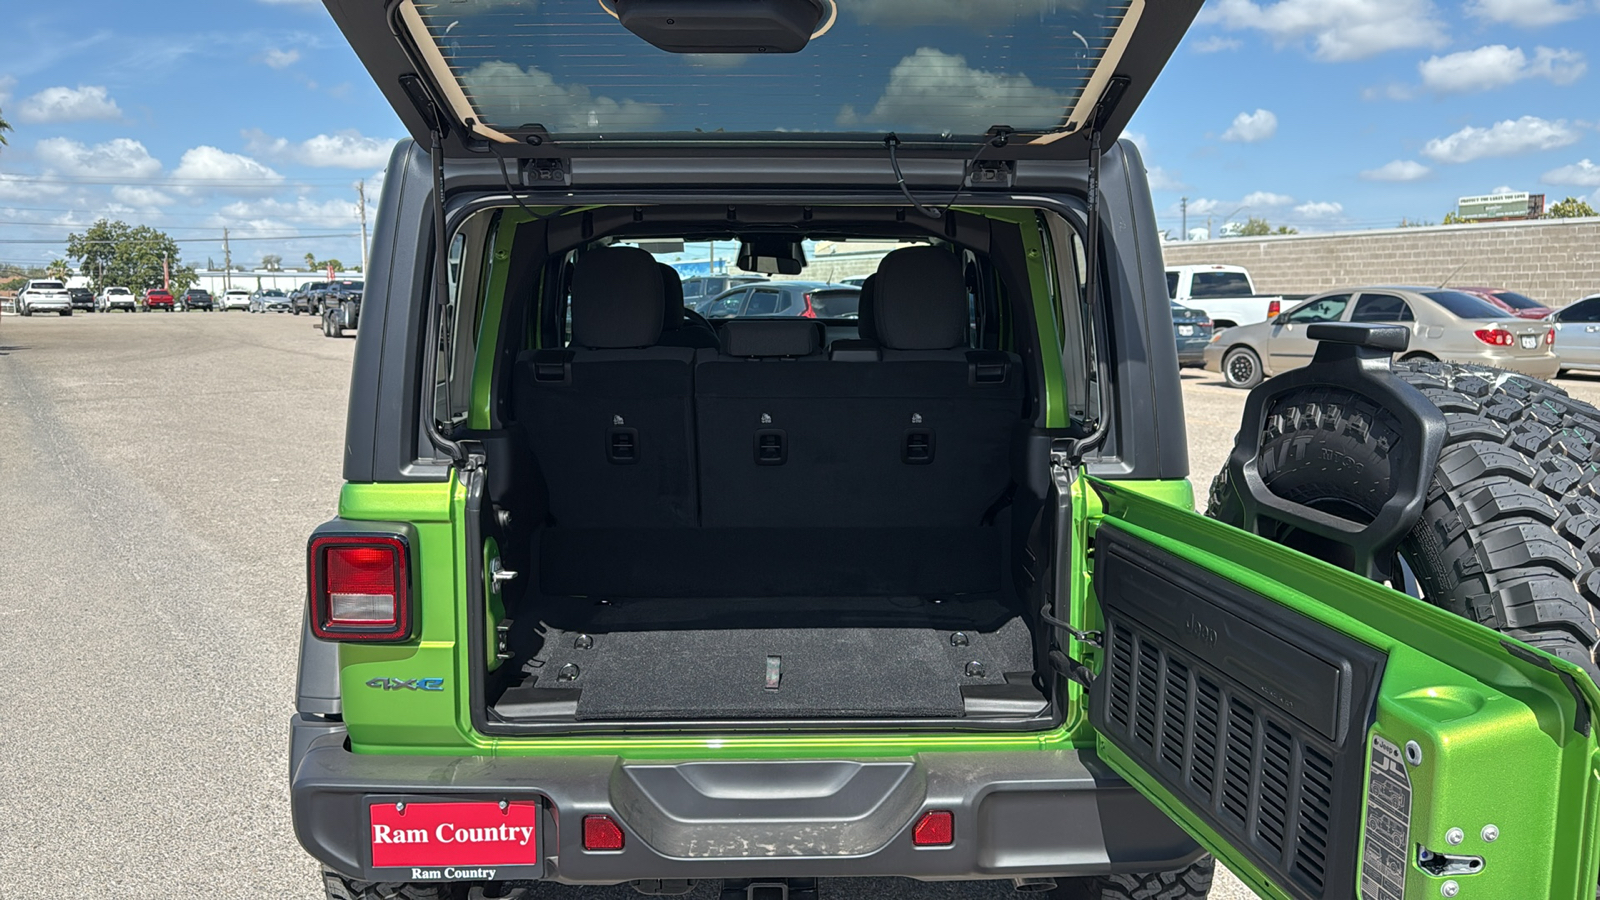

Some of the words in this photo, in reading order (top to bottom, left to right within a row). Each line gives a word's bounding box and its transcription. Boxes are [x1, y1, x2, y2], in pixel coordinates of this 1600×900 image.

[1186, 613, 1218, 649] Jeep
[1379, 741, 1393, 755] Jeep
[1372, 756, 1406, 779] JL
[373, 824, 429, 844] Ram
[435, 823, 533, 846] Country
[412, 868, 441, 879] Ram
[444, 867, 496, 880] Country
